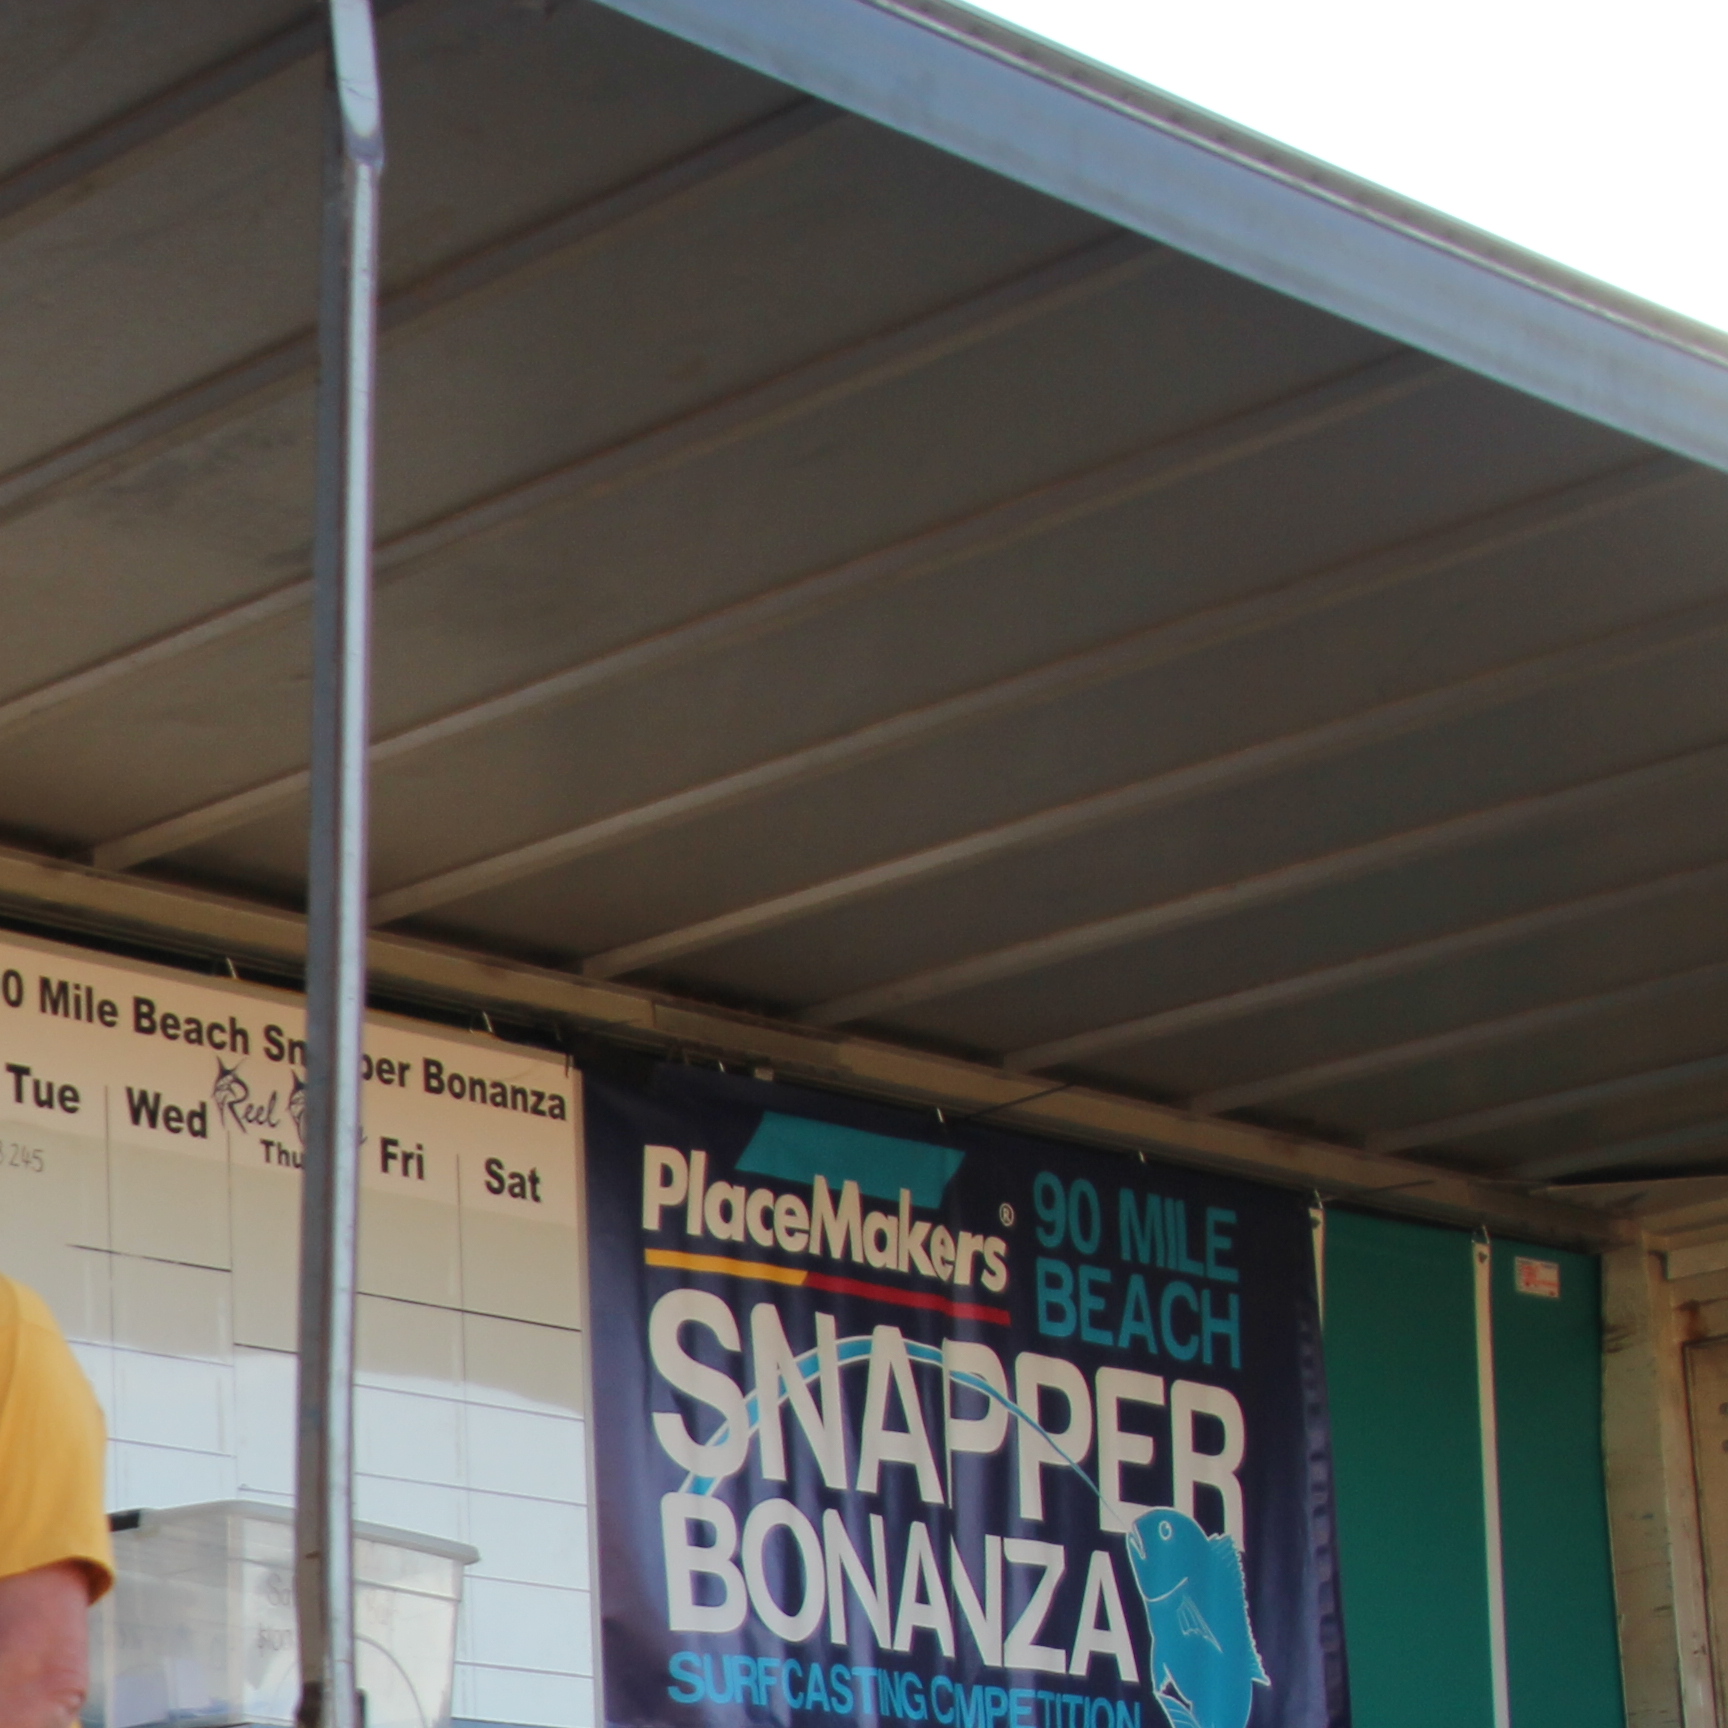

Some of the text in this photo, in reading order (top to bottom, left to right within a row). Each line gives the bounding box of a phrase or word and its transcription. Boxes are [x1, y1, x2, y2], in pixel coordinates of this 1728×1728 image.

[38, 976, 118, 1029] Mile
[132, 998, 249, 1055] Beach
[423, 1058, 567, 1122] Bonanza
[5, 1063, 81, 1115] Tue
[125, 1086, 208, 1140] Wed
[380, 1137, 425, 1181] Fri
[484, 1157, 541, 1202] Sat
[643, 1145, 1009, 1291] PlaceMakers
[1033, 1171, 1238, 1283] 90 MILE
[1035, 1258, 1240, 1368] BEACH
[648, 1288, 1245, 1553] SNAPPER
[660, 1491, 1139, 1684] BONANZA
[667, 1650, 926, 1721] SURFCASTING
